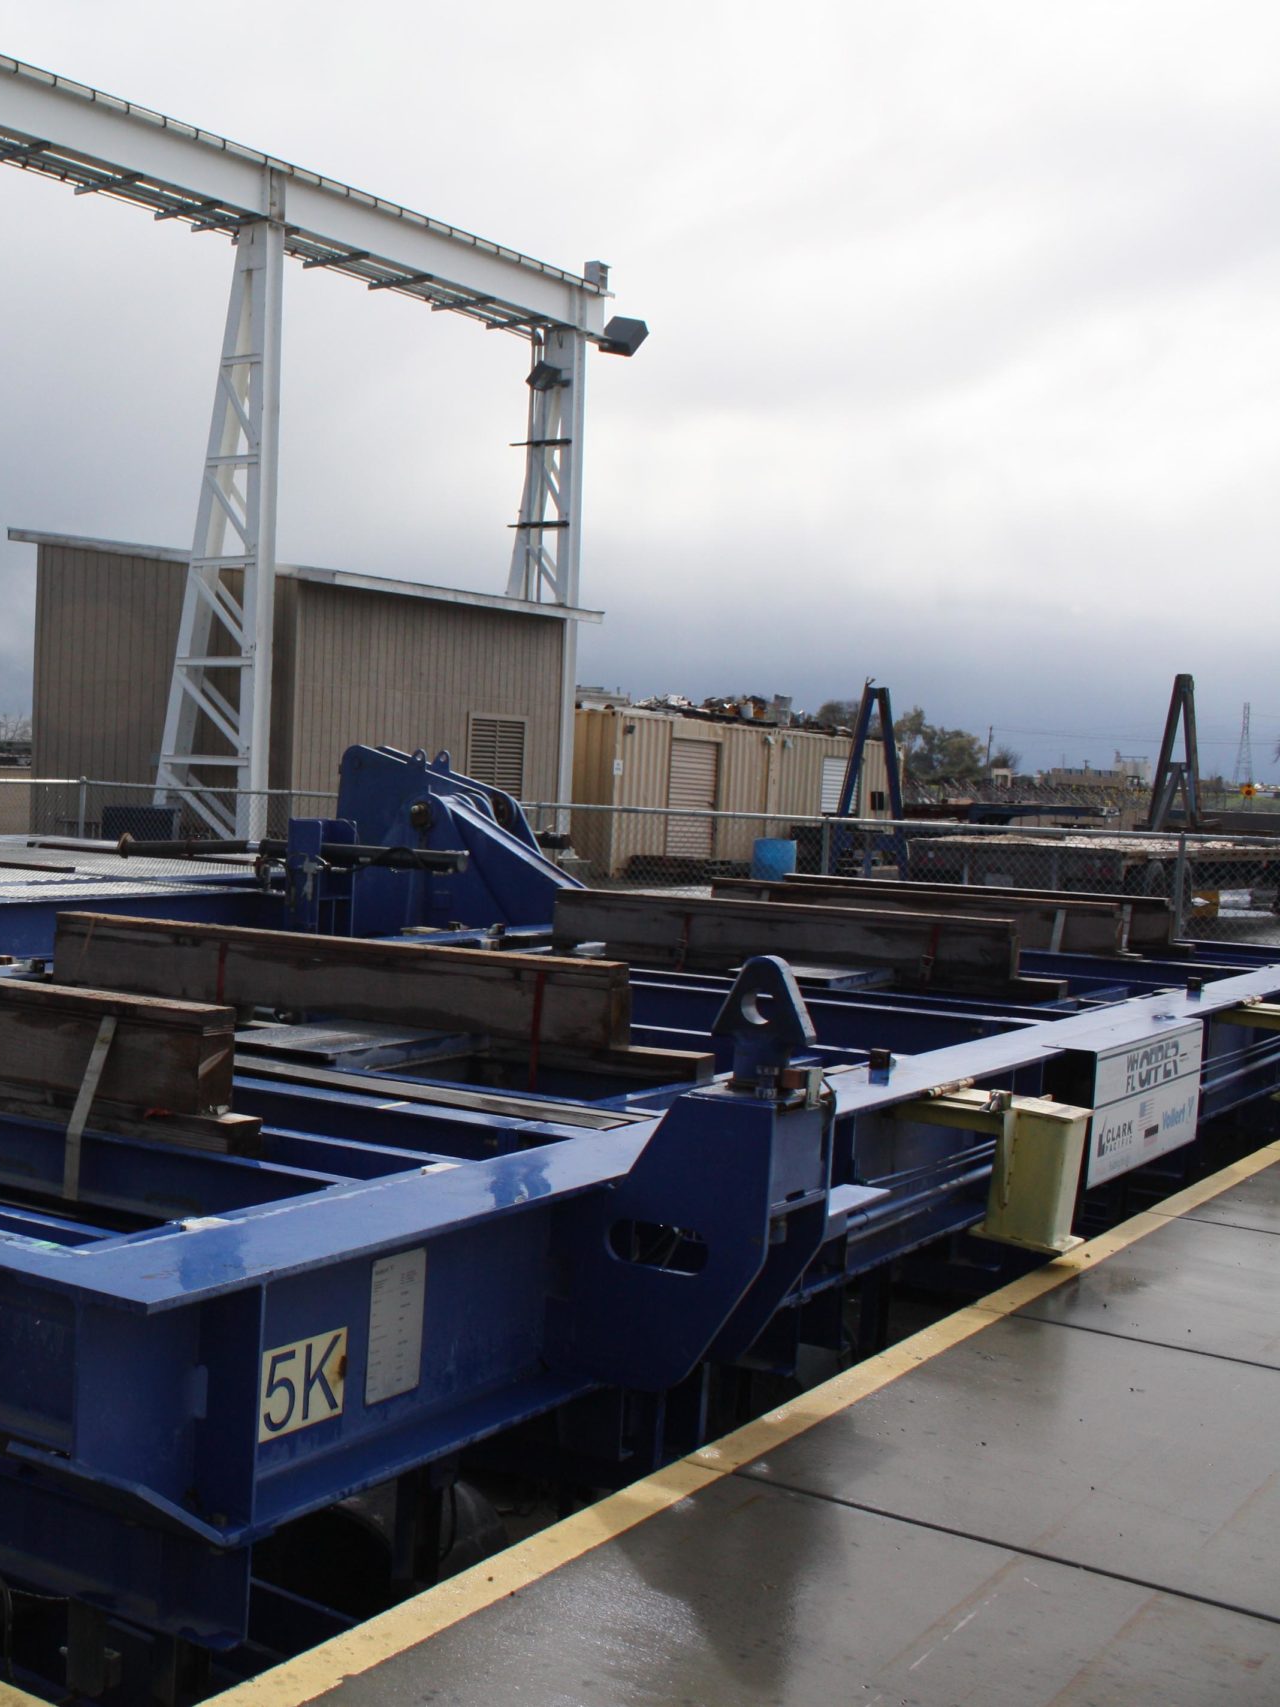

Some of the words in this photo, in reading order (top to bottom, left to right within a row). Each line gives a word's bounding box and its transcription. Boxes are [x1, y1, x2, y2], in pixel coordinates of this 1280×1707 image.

[1105, 1120, 1133, 1144] CLARK
[1104, 1135, 1133, 1154] PACIFIC
[263, 1333, 343, 1433] 5K
